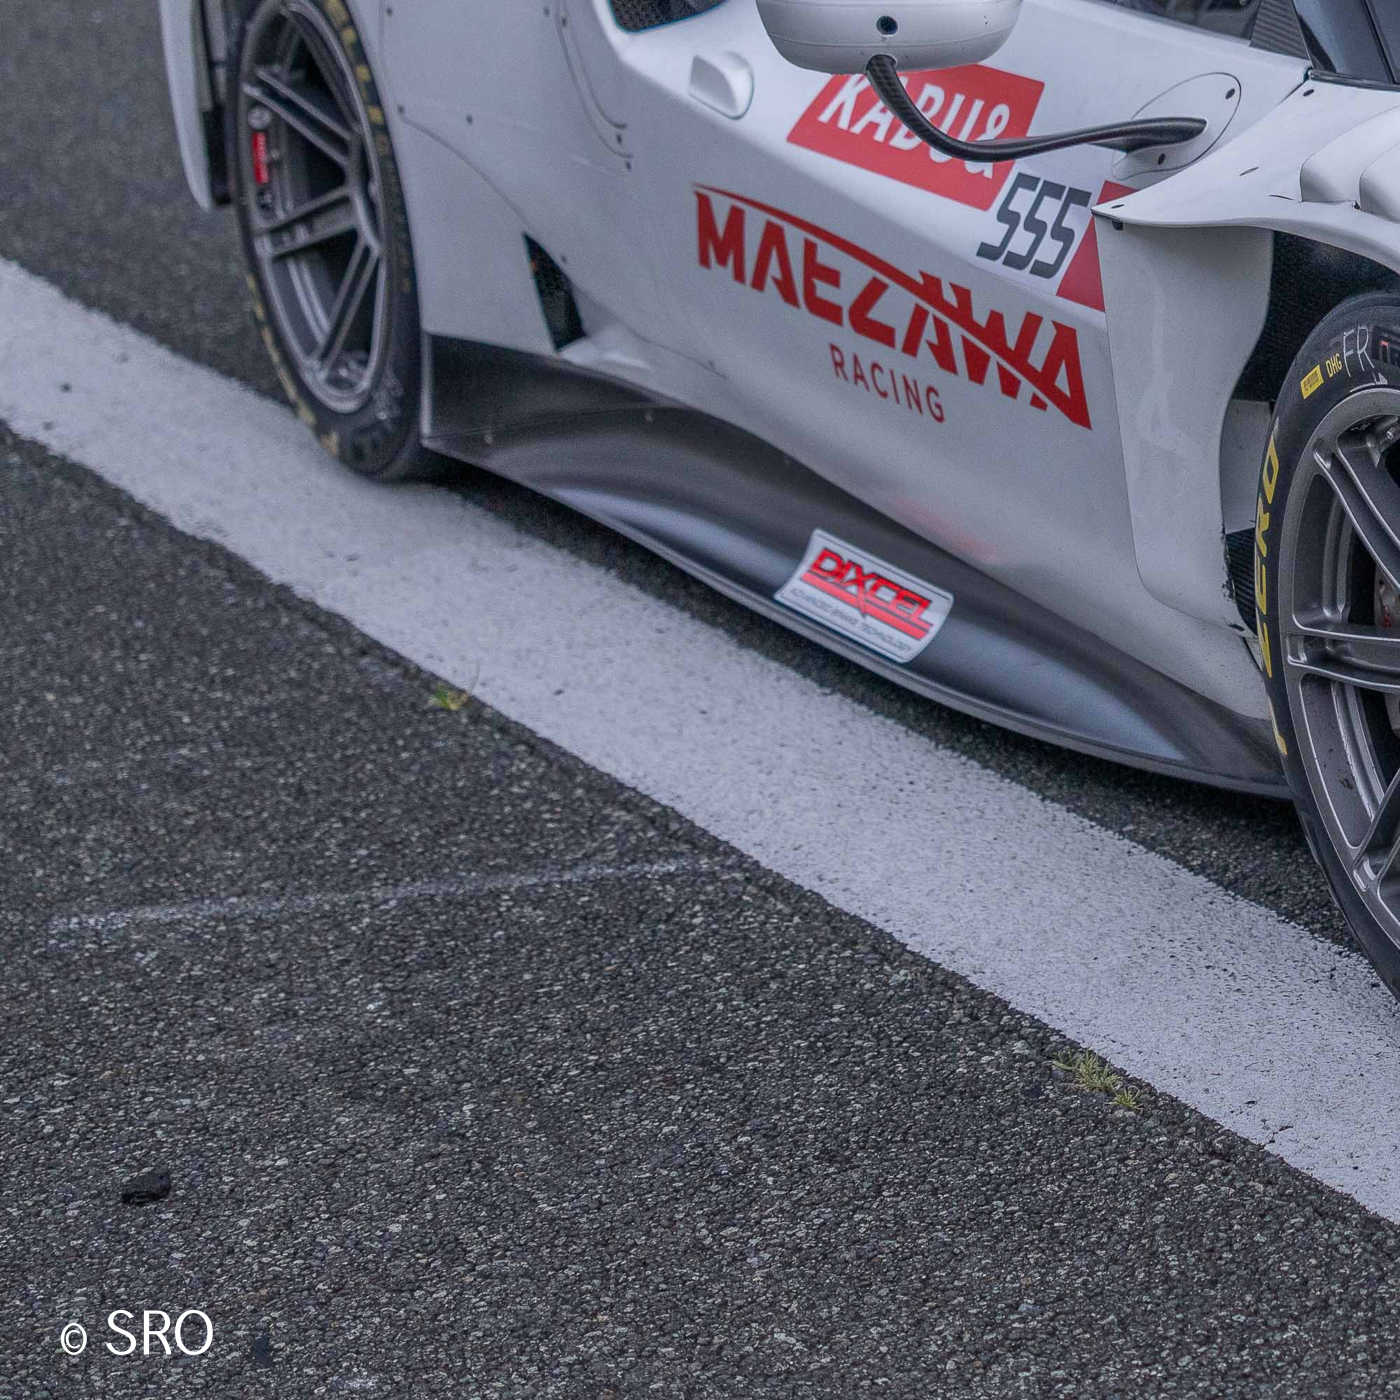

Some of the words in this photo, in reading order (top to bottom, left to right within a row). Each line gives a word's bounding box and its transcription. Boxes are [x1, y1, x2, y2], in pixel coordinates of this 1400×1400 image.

[975, 171, 1093, 280] 555
[690, 181, 1094, 432] MAEZAWA
[828, 342, 946, 424] RACING
[1342, 324, 1375, 378] FR
[807, 546, 934, 628] DIXEL
